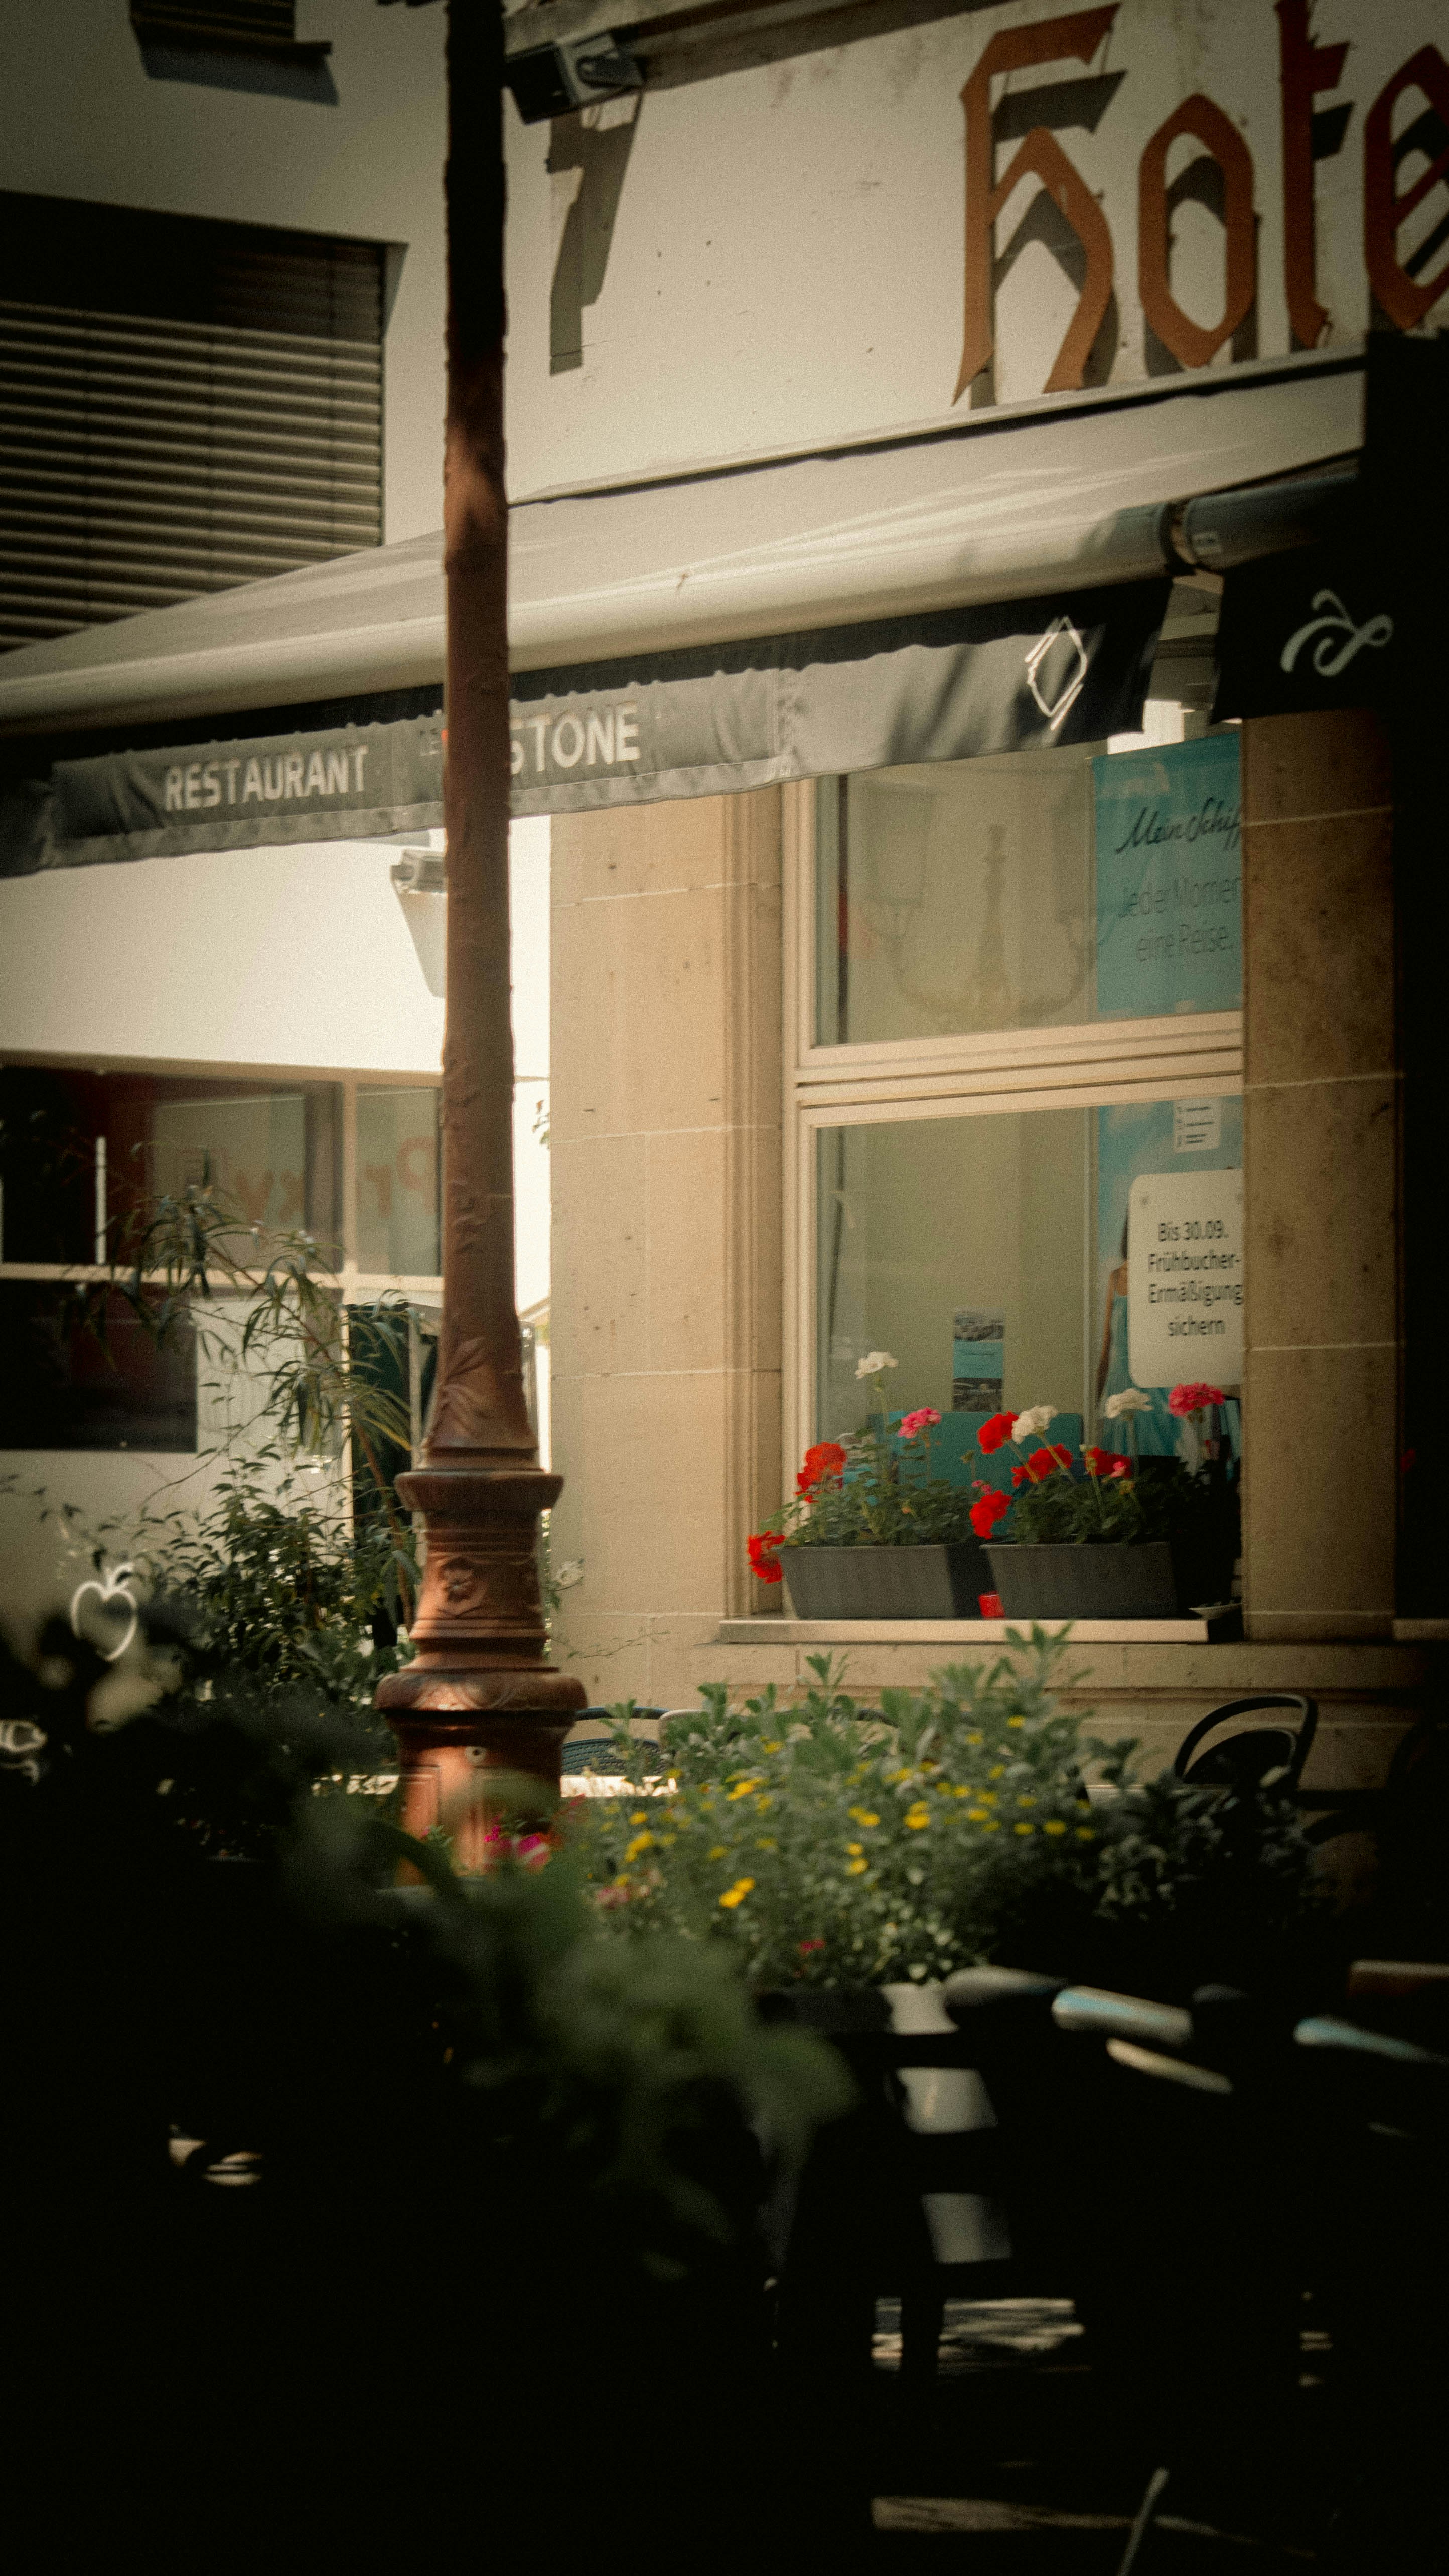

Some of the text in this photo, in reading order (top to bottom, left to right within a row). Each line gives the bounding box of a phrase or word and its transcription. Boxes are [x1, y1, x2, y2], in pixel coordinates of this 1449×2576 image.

[165, 745, 369, 811] RESTAURANT
[1115, 806, 1183, 854] Mein
[1136, 928, 1175, 962] eine
[1158, 1220, 1228, 1242] Bis 30.09.
[1148, 1249, 1241, 1272] Frühbucher-
[1149, 1280, 1243, 1306] Ermäßigung
[1168, 1315, 1225, 1336] sichern
